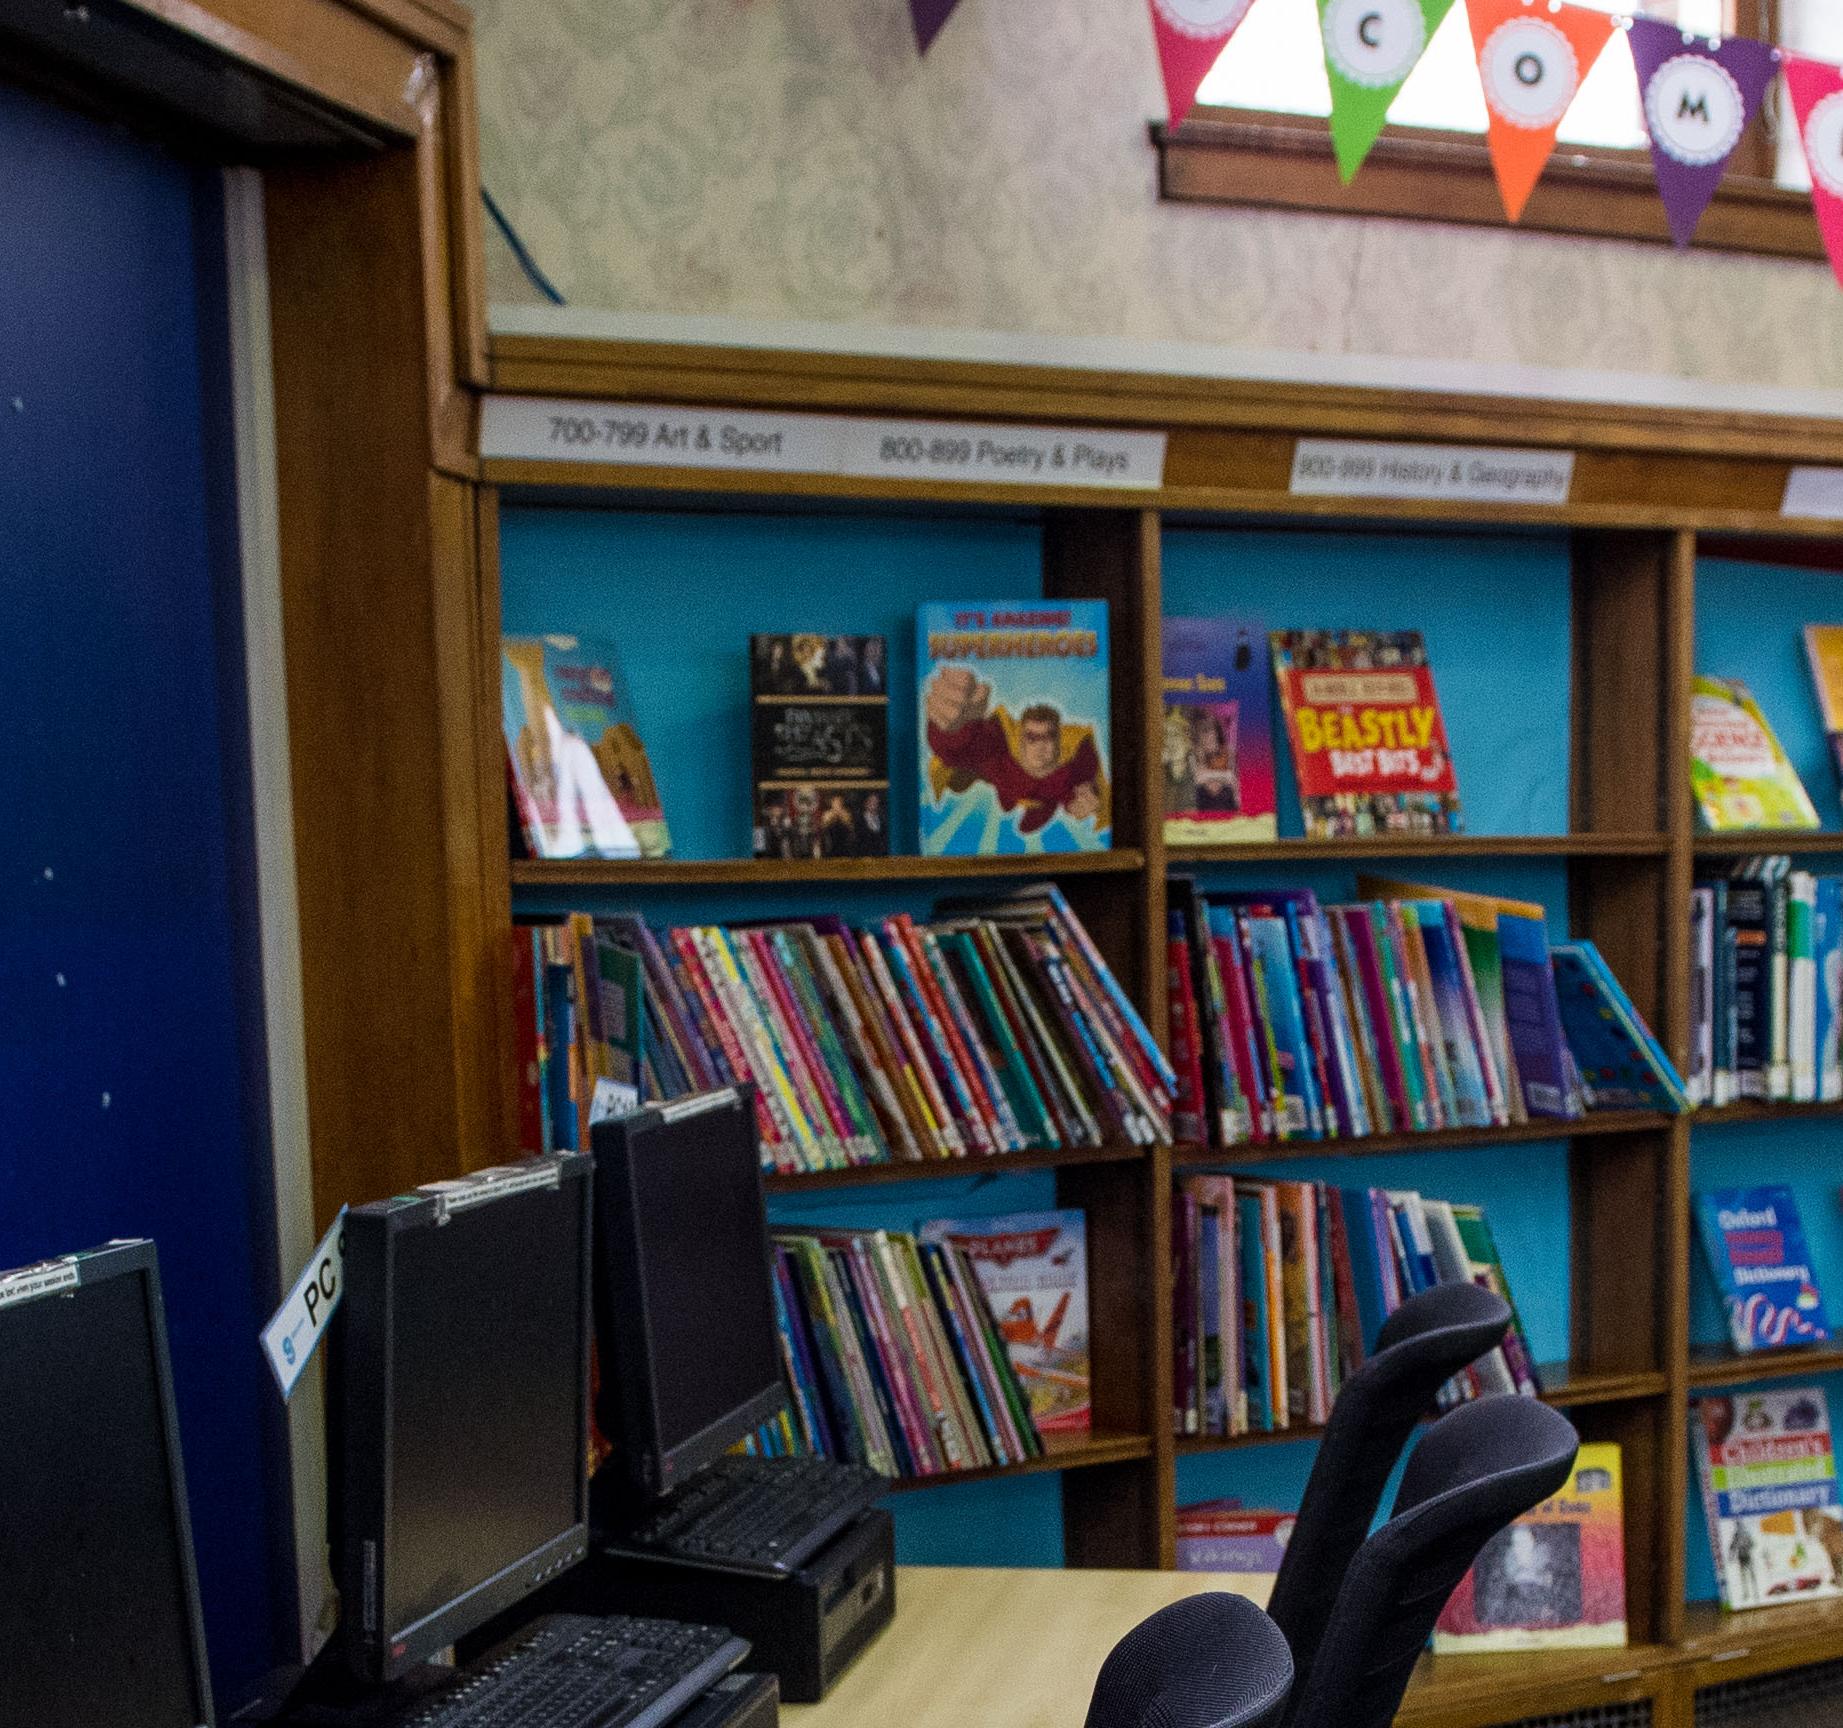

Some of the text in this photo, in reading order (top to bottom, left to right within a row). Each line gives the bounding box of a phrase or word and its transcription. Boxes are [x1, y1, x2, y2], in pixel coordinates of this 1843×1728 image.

[549, 416, 784, 456] 700-799 Art & Sport
[879, 435, 1130, 476] 800-899 Poetry & Plays
[1296, 706, 1436, 752] BEASTLY
[304, 1258, 337, 1328] PC
